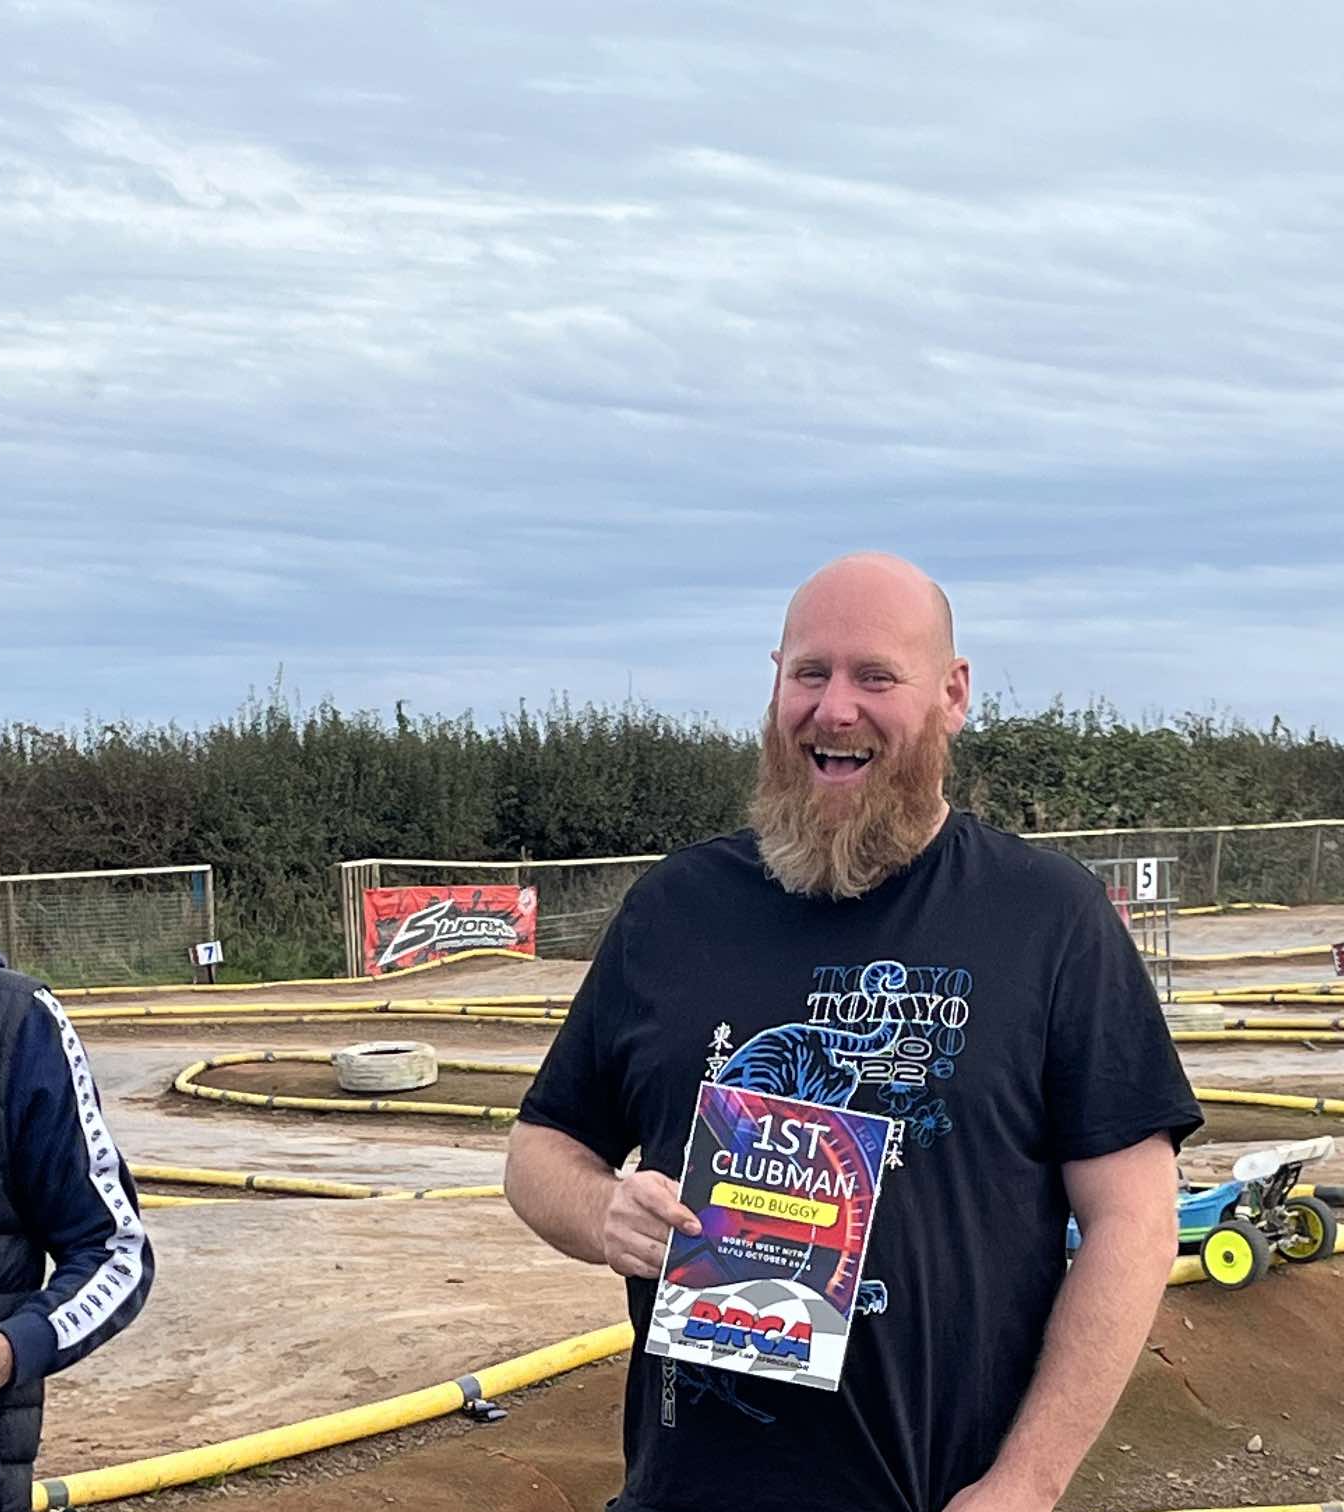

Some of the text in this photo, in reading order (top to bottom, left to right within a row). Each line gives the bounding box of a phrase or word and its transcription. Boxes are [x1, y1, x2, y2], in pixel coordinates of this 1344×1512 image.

[1142, 862, 1152, 889] 5
[203, 945, 214, 961] 7
[807, 991, 969, 1029] TOKYO
[752, 1114, 831, 1160] 1ST
[712, 1150, 856, 1200] CLUBMAN
[730, 1191, 820, 1220] 2WD BUGGY
[721, 1236, 754, 1249] NORTH
[755, 1242, 781, 1254] WEST
[745, 1250, 787, 1266] OCTOBER
[682, 1300, 813, 1362] BRCA
